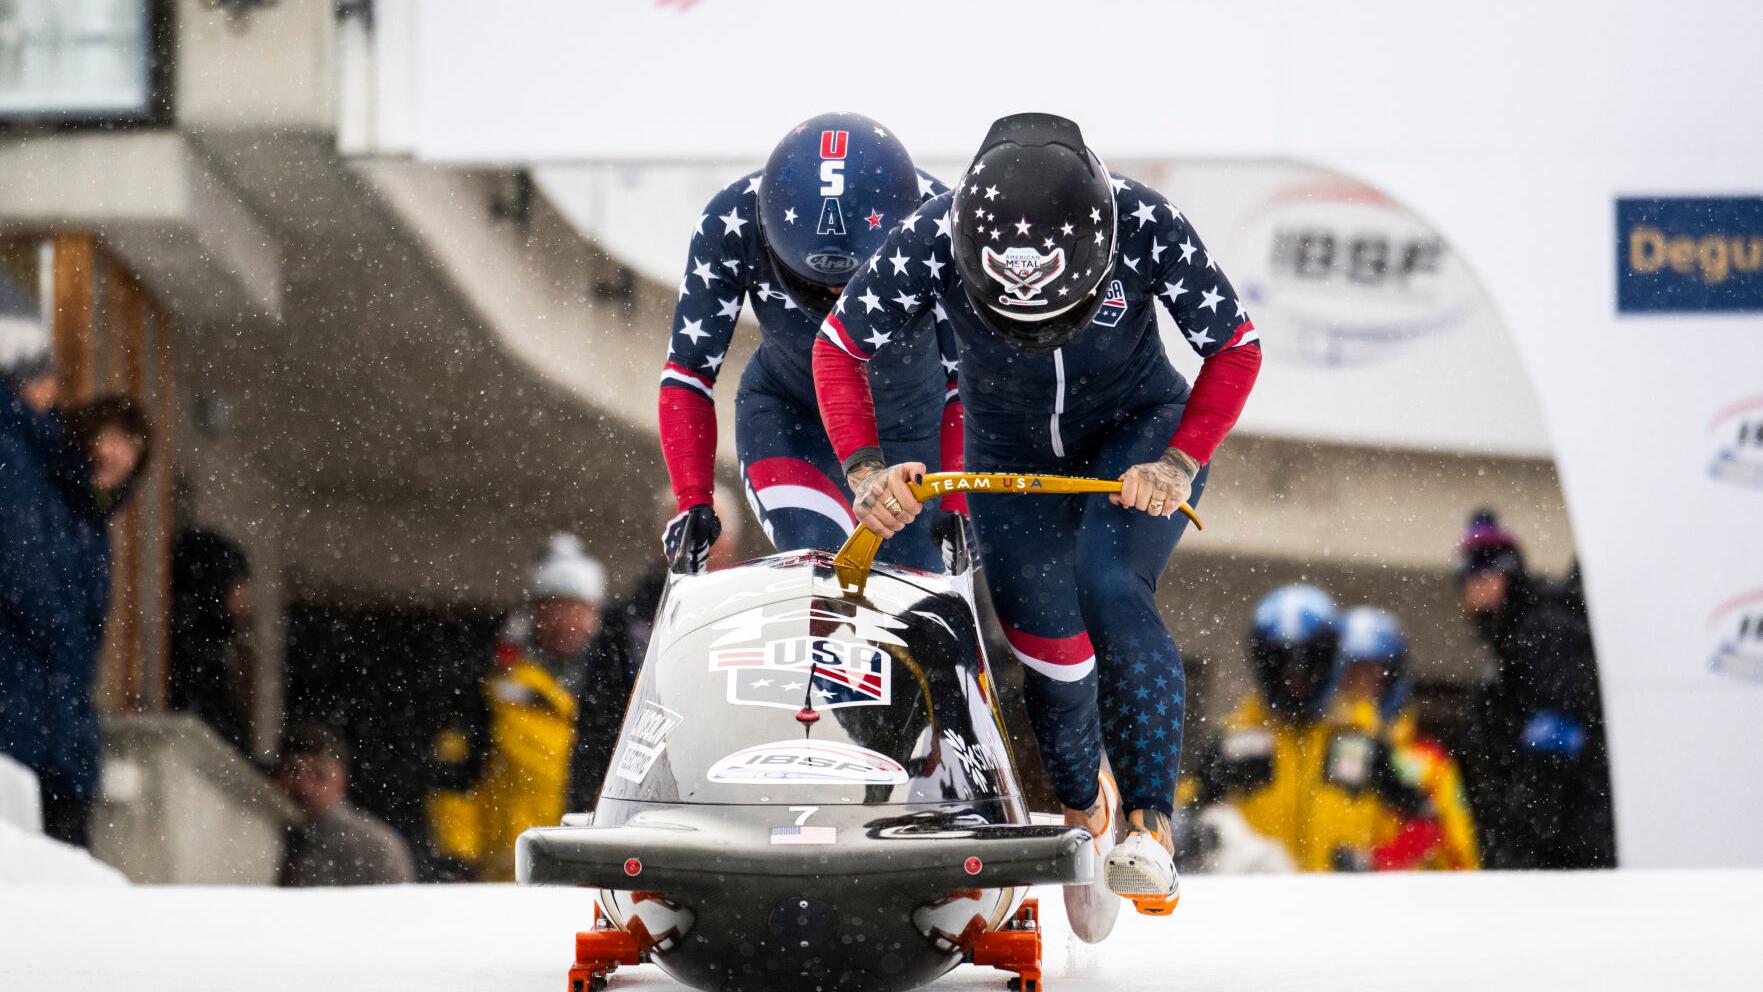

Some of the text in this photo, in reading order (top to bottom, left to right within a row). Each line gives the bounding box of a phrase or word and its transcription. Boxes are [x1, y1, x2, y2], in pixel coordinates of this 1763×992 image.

[817, 130, 849, 235] USA
[817, 255, 853, 269] Arai
[1006, 260, 1040, 268] METAL
[931, 478, 1043, 493] TEAM USA
[774, 639, 882, 674] USA
[746, 754, 873, 773] IBSF
[788, 806, 820, 827] 7
